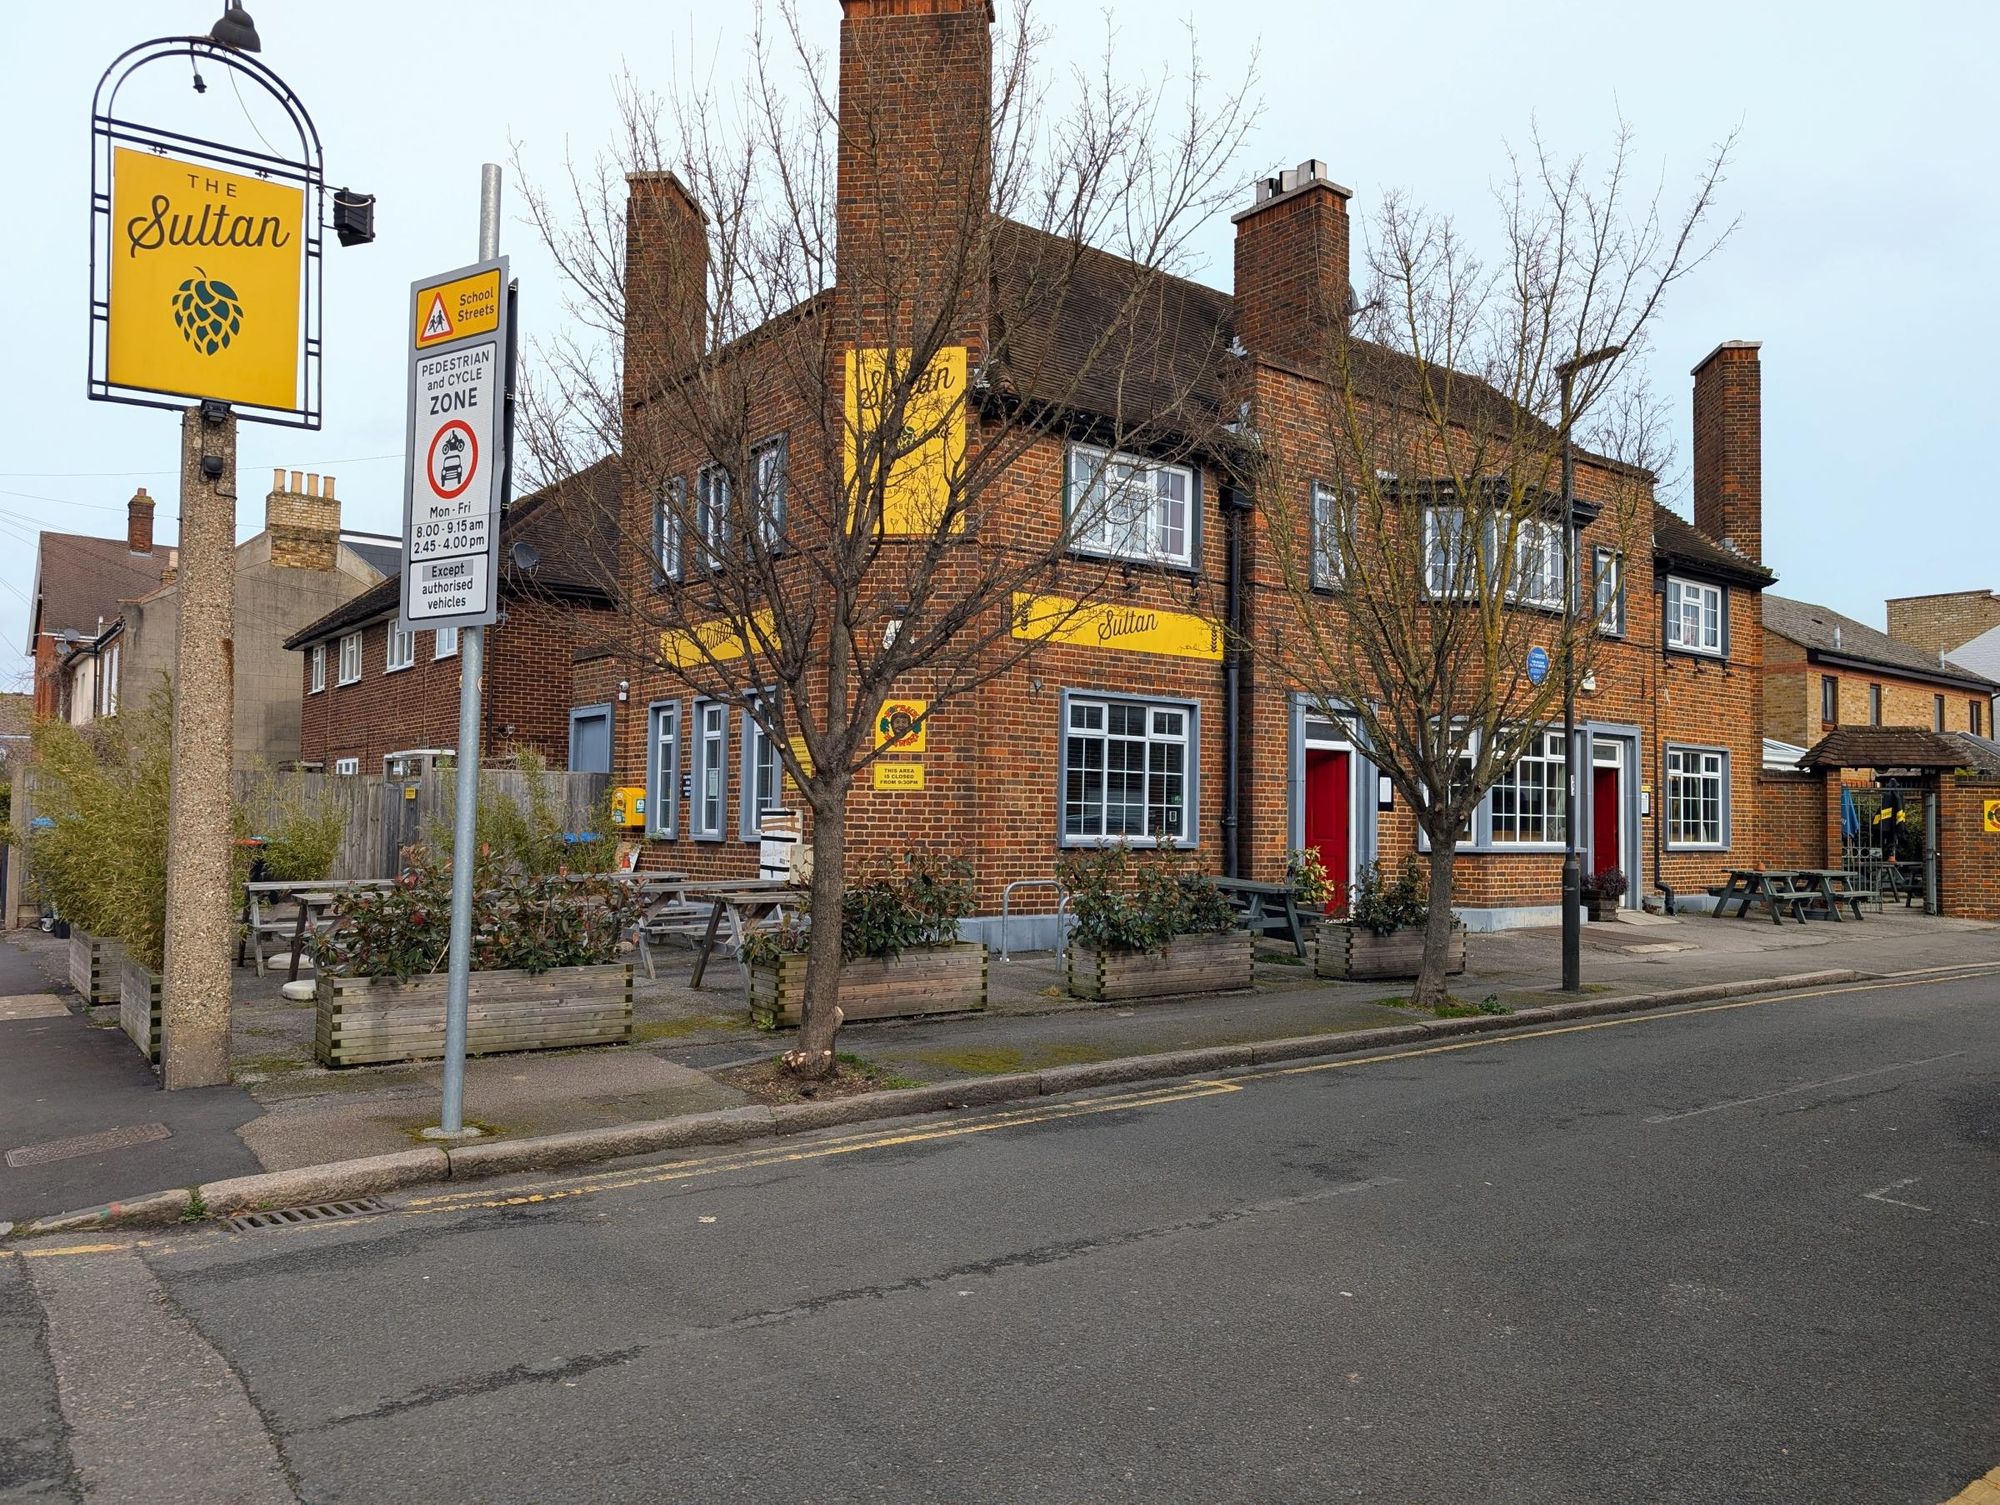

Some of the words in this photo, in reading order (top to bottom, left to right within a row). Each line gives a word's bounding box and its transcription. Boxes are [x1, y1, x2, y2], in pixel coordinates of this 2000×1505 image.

[187, 174, 237, 198] THE
[127, 194, 290, 258] Sultan
[459, 286, 494, 307] School
[457, 304, 495, 322] Streets
[422, 350, 490, 377] PEDESTRIAN
[427, 377, 445, 391] and
[448, 367, 482, 386] CYCLE
[430, 387, 478, 416] ZONE
[430, 506, 450, 519] Mon
[458, 501, 471, 514] Fri
[416, 524, 440, 538] 8.00
[447, 520, 467, 534] 9.15
[469, 520, 484, 531] am
[414, 540, 436, 554] 2.45
[443, 535, 468, 549] 4.00
[469, 536, 485, 549] pm
[431, 562, 465, 578] Except
[422, 577, 473, 595] authorised
[428, 596, 466, 610] vehicles
[1098, 609, 1159, 645] Sultan
